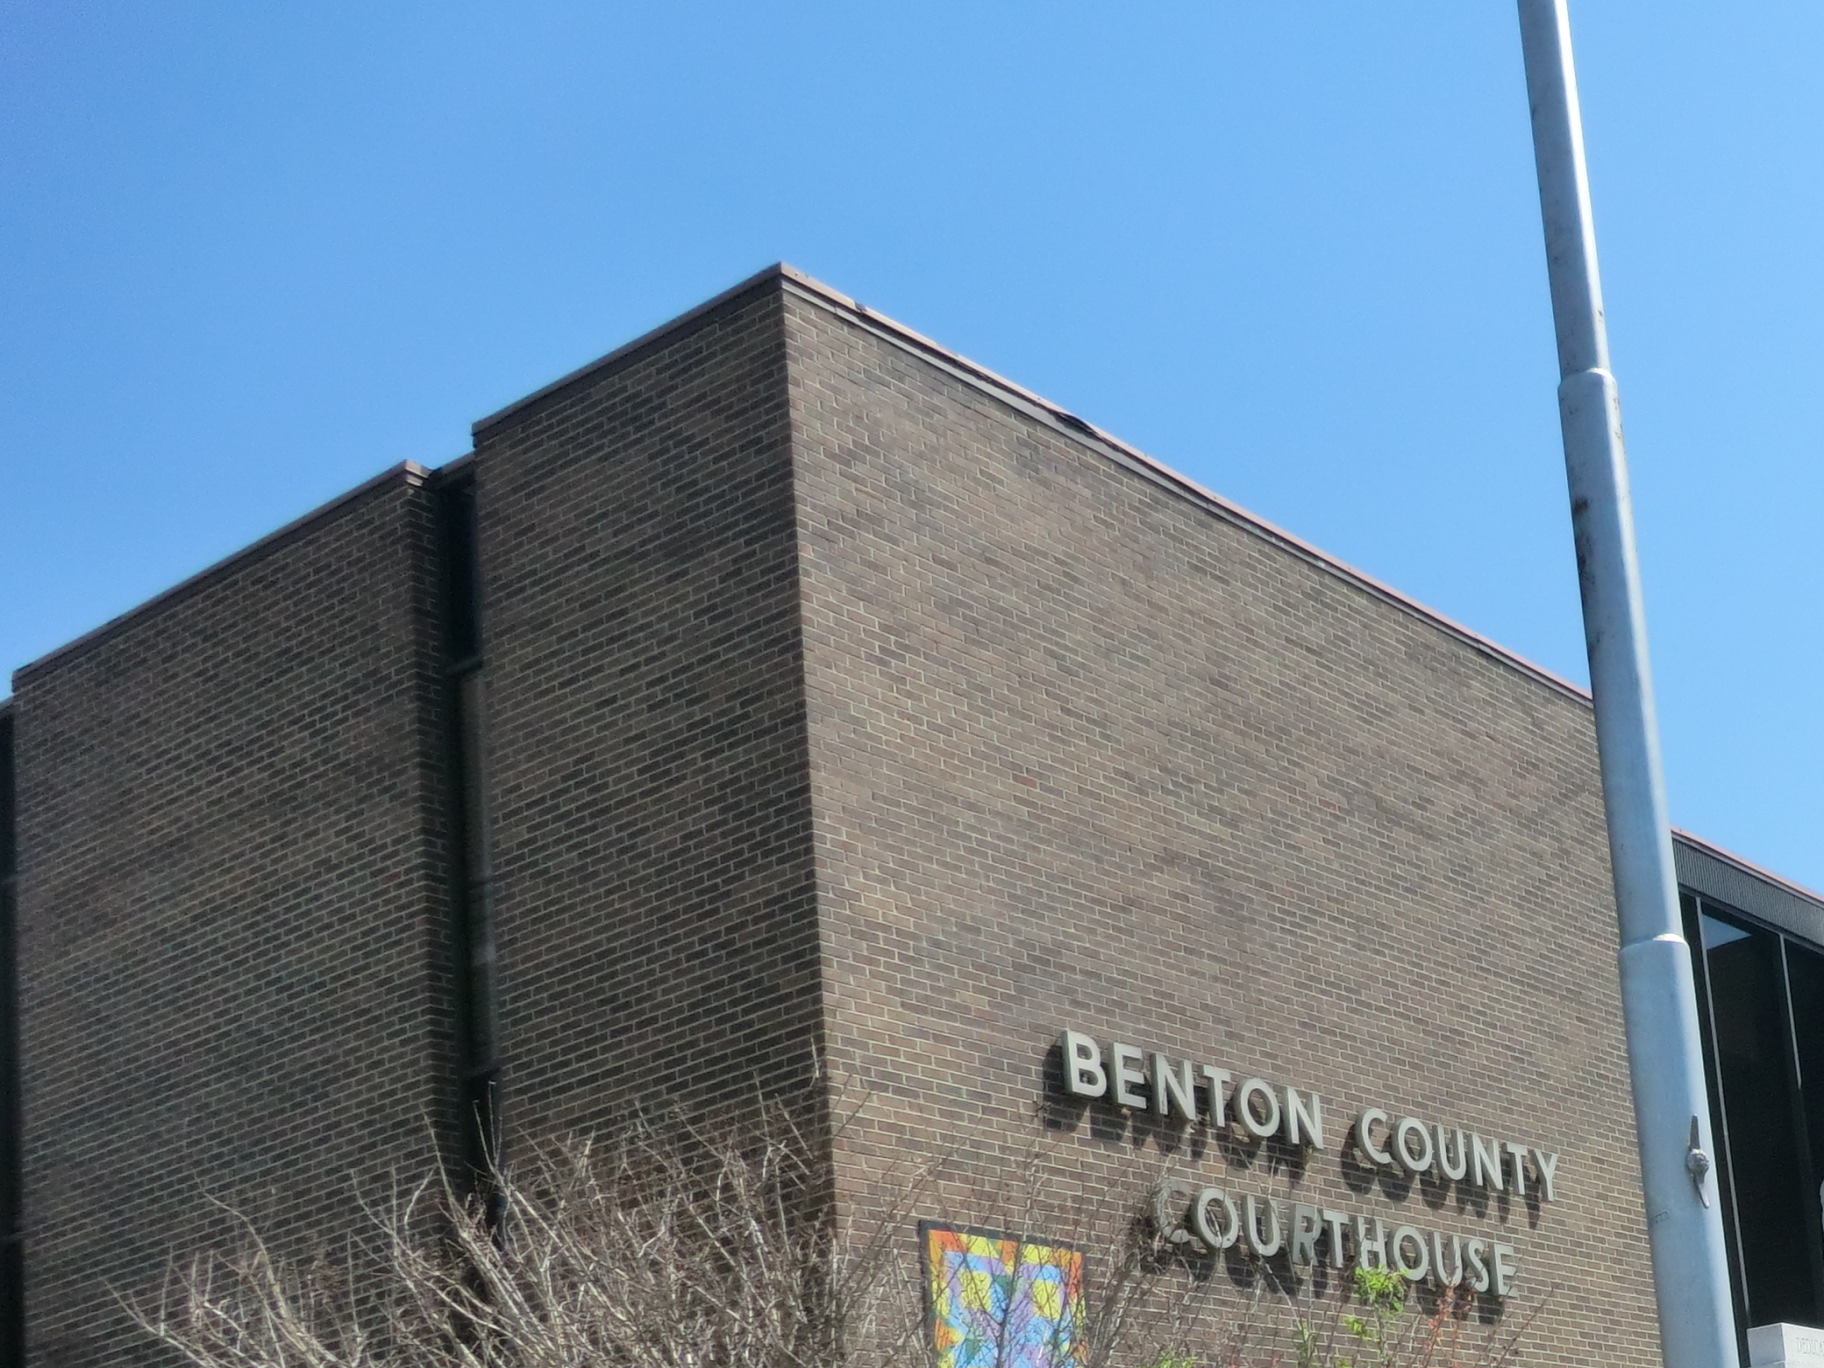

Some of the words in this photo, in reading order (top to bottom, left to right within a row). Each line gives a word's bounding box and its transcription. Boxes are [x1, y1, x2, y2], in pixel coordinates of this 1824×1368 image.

[1061, 1029, 1324, 1150] BENTON
[1354, 1106, 1558, 1201] COUNTY
[1151, 1176, 1518, 1298] COURTHOUSE
